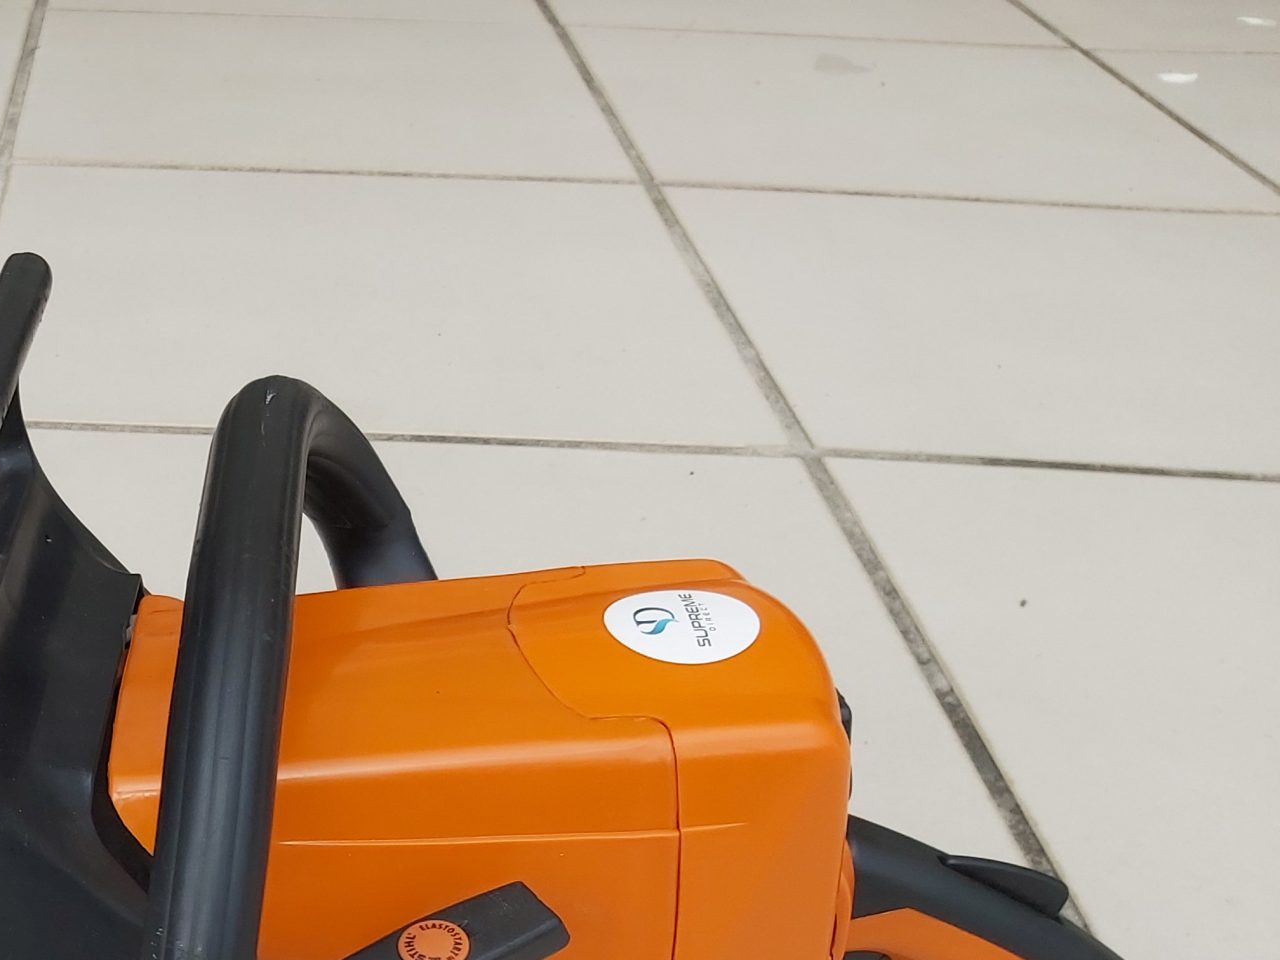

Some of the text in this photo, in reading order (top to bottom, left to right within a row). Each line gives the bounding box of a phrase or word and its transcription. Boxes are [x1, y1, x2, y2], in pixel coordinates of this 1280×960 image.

[677, 592, 712, 648] SUPREME
[697, 602, 717, 632] DIRECT
[418, 922, 463, 959] ELASTOSTART
